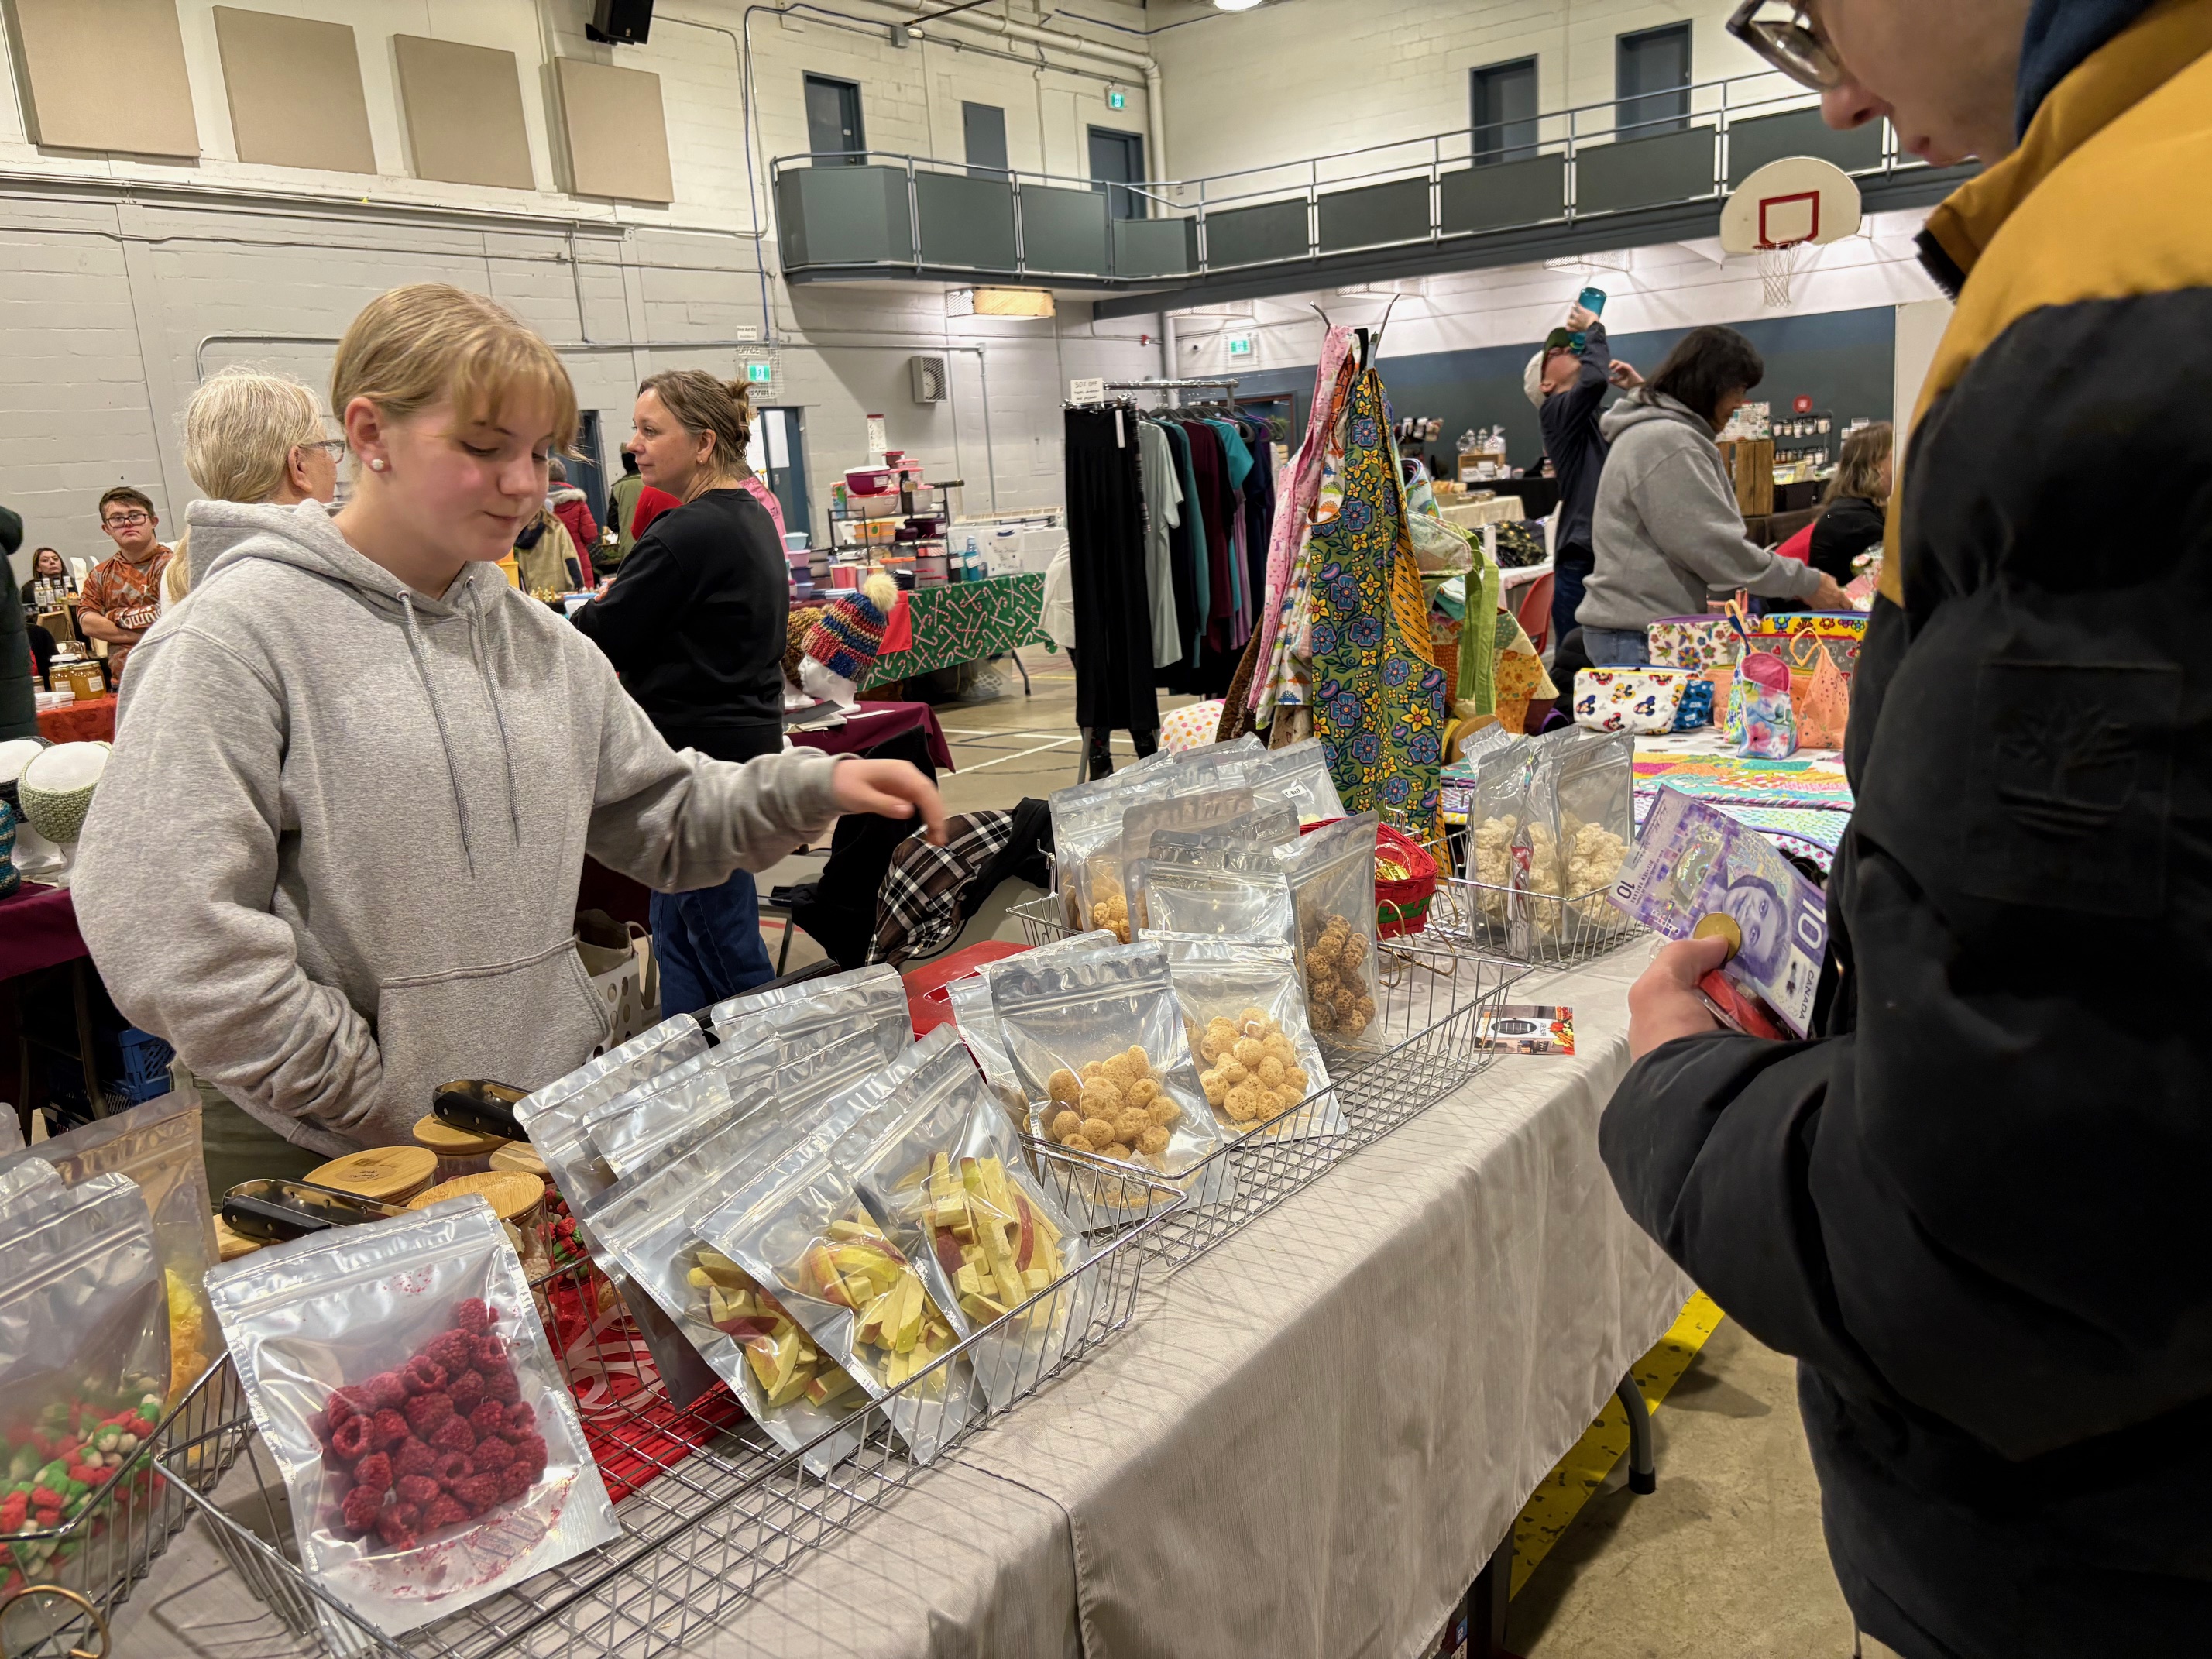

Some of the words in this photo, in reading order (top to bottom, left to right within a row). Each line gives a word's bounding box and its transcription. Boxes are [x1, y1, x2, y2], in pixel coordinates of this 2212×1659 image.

[1285, 788, 1301, 796] T-Ball
[1616, 880, 1635, 899] 10
[1798, 898, 1827, 950] 10
[1798, 970, 1815, 1020] CANADA
